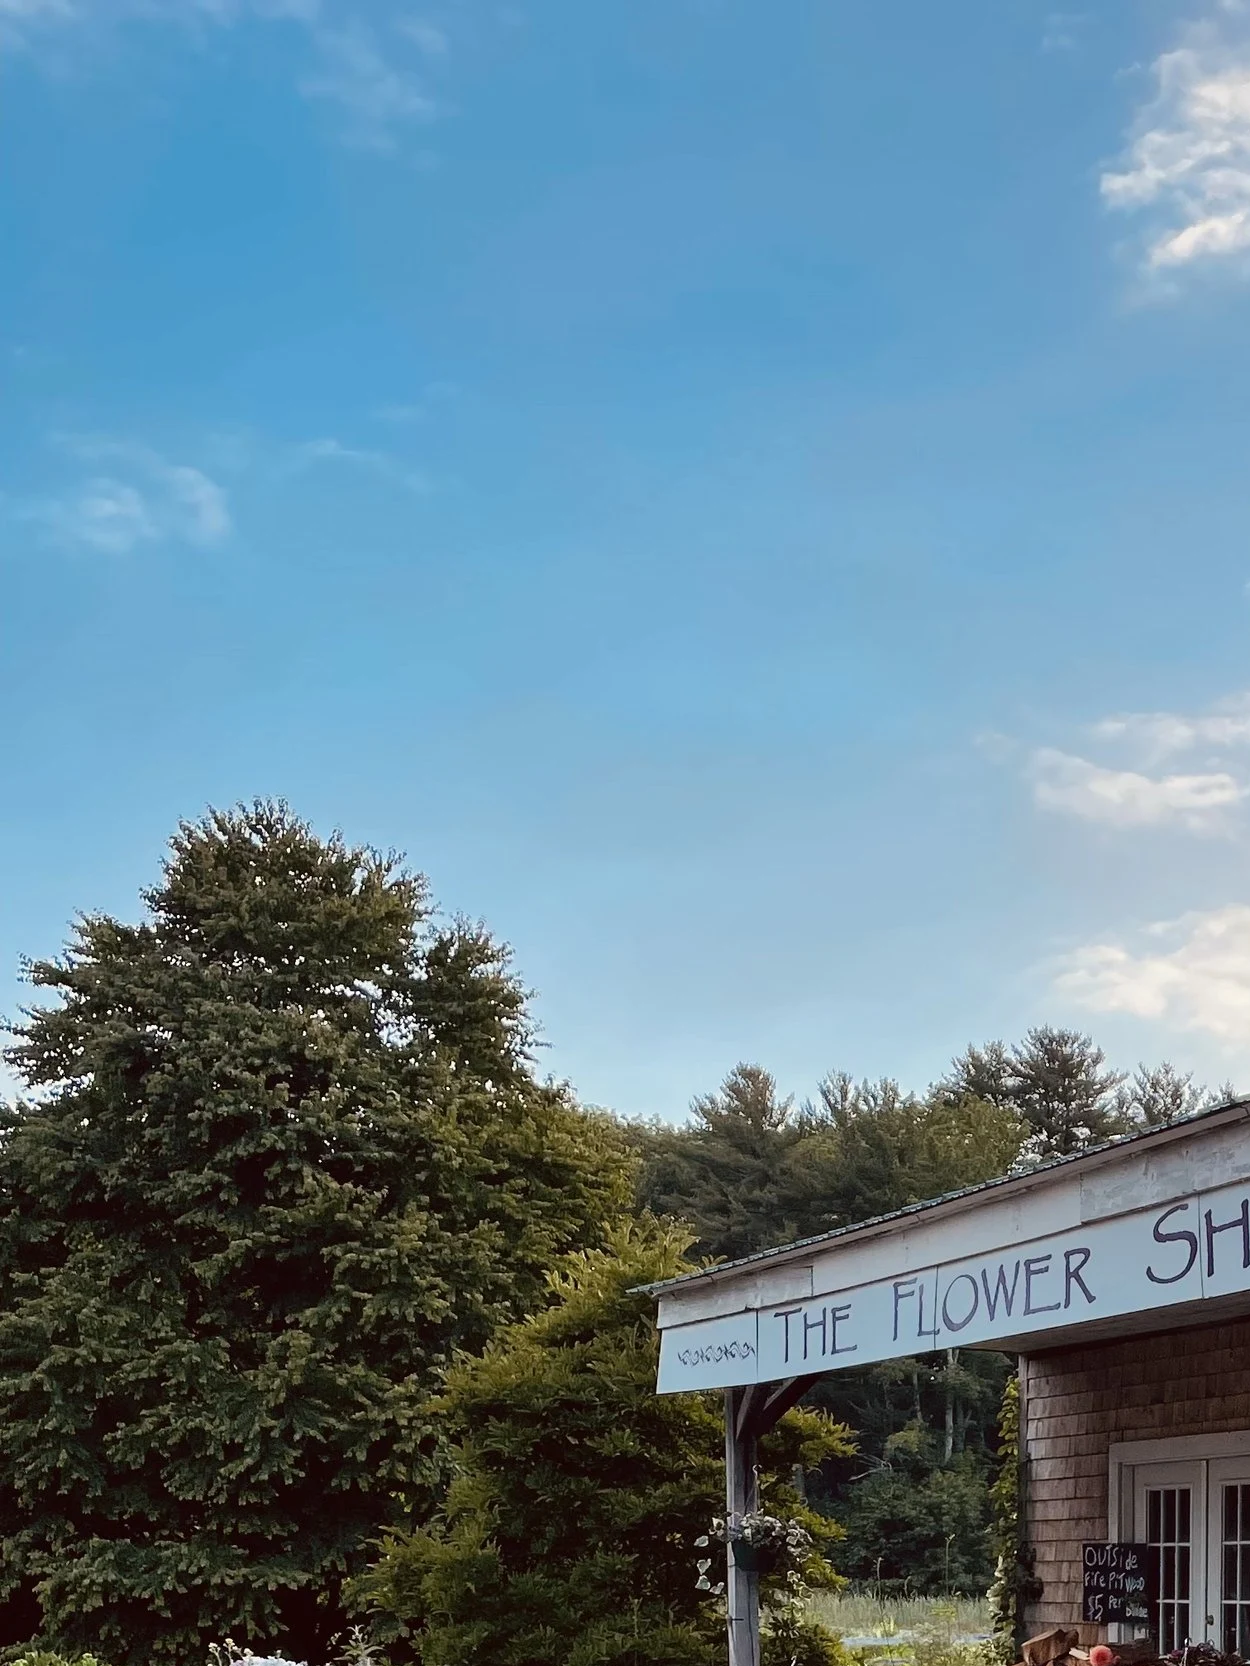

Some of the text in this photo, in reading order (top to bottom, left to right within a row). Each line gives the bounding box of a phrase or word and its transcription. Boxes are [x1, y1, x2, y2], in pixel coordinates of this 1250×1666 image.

[774, 1303, 857, 1363] THE
[892, 1247, 1097, 1342] FLOWER
[1087, 1593, 1104, 1621] $5
